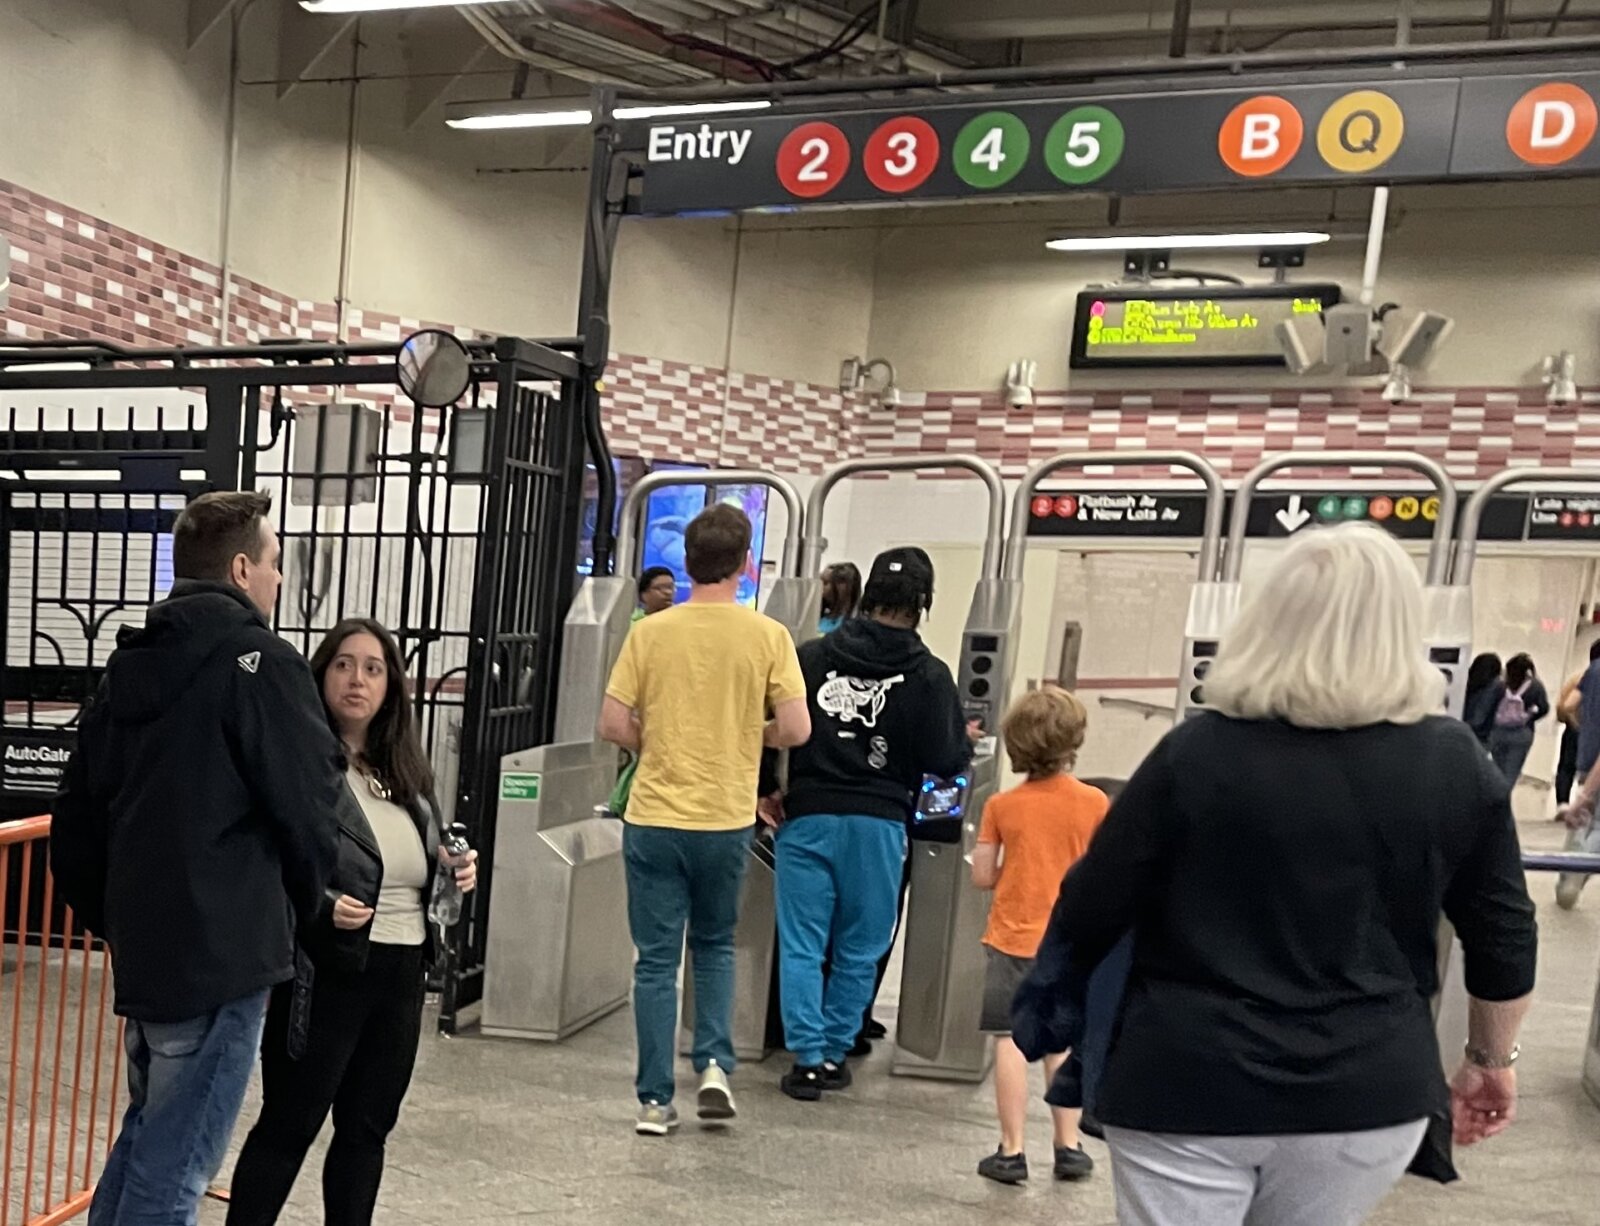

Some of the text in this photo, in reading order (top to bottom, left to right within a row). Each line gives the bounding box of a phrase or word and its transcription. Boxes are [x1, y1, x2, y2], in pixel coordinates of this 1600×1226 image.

[647, 100, 1576, 182] Entry 2 3 4 5 B Q D
[1078, 495, 1136, 508] Flatbush
[1139, 495, 1157, 508] Av
[1093, 508, 1123, 521] New
[1127, 508, 1157, 521] Lots
[1161, 507, 1180, 520] Av
